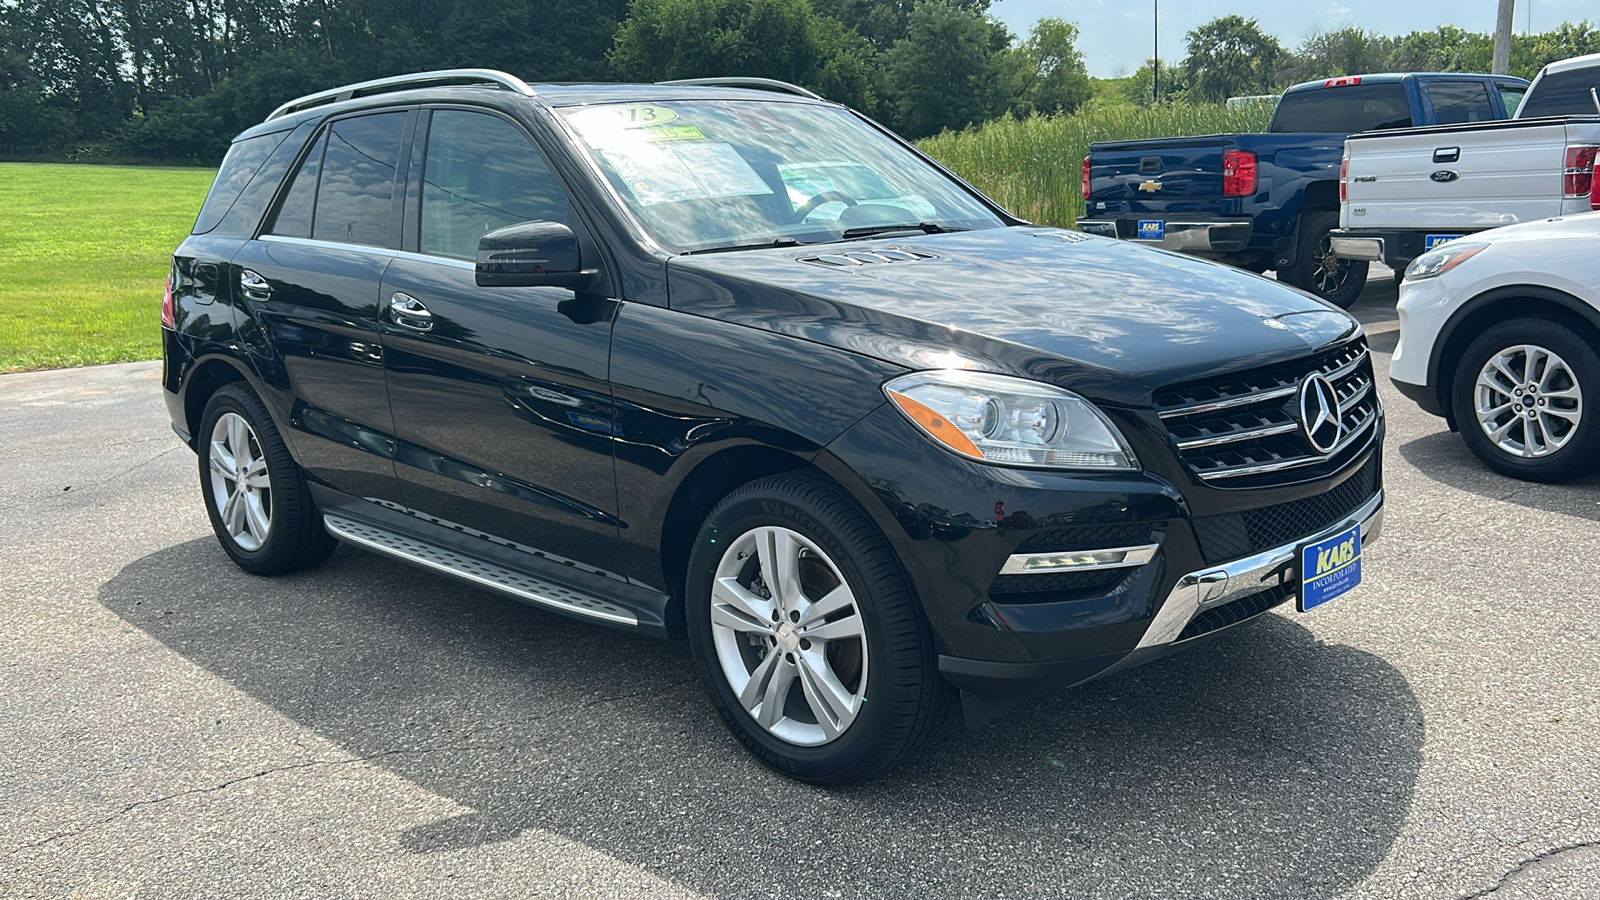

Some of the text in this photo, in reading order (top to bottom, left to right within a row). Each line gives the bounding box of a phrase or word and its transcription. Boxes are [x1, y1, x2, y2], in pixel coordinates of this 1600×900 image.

[784, 507, 848, 562] MICHELIN
[1316, 537, 1355, 575] KARS
[1312, 562, 1357, 590] INCORPORATED
